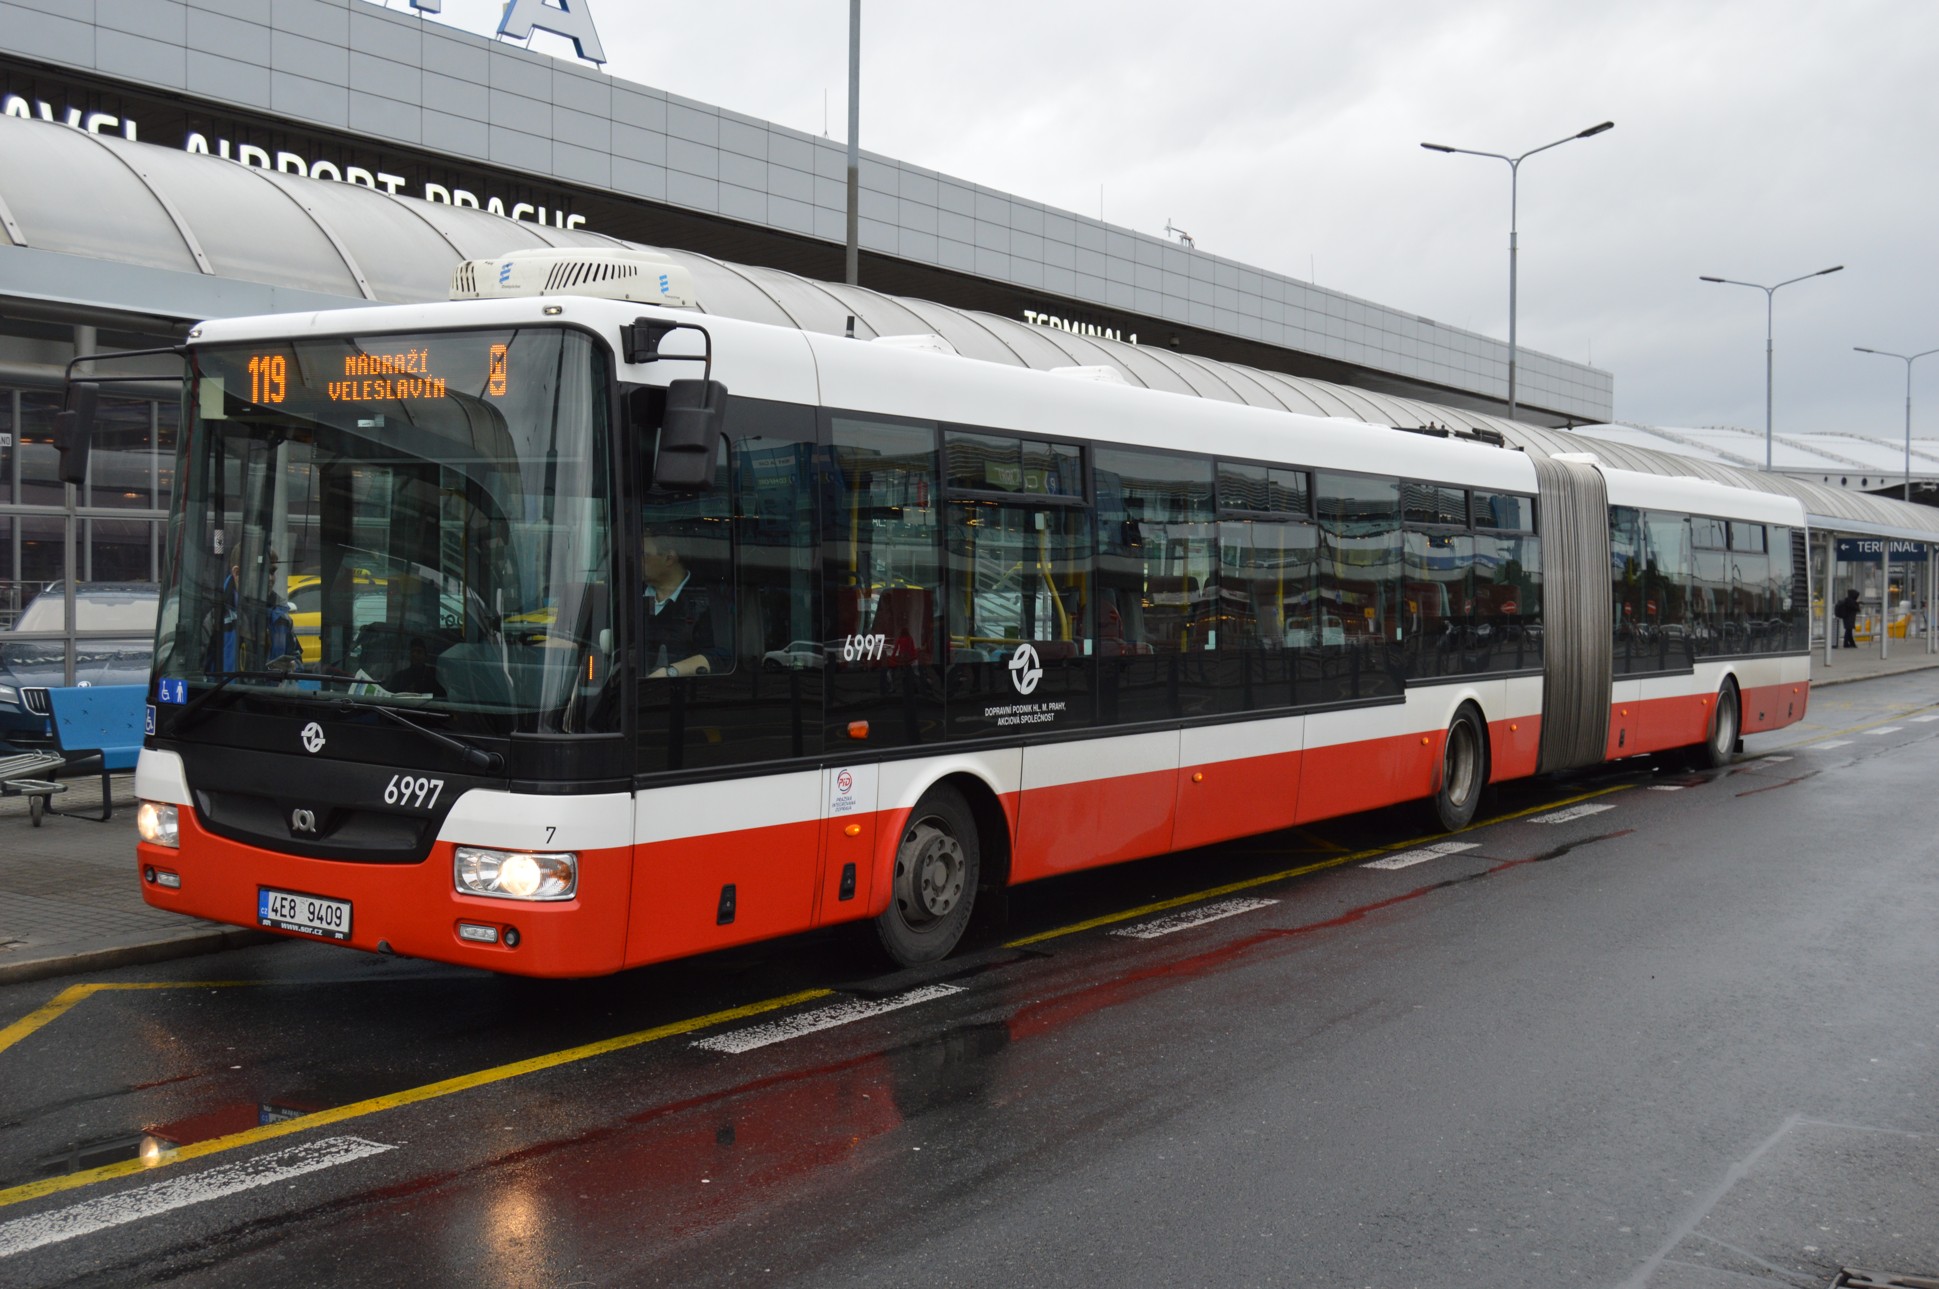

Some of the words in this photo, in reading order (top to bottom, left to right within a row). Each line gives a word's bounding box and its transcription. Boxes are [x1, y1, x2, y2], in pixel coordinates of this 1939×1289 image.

[248, 355, 286, 404] 119
[345, 348, 430, 376] NÁDRAŽÍ
[328, 373, 445, 401] VELESLAVÍN
[843, 634, 886, 662] 6997
[984, 703, 1012, 717] DOPRAVNÍ
[1012, 704, 1033, 714] PODNIK
[997, 714, 1021, 727] AKCIOVÁ
[1020, 712, 1055, 724] SPOLEČNOST
[384, 774, 445, 809] 6997
[545, 826, 557, 844] 7
[260, 907, 268, 915] CZ
[271, 895, 297, 919] 4E8
[307, 902, 343, 928] 9409
[280, 922, 323, 936] www.sor.cz
